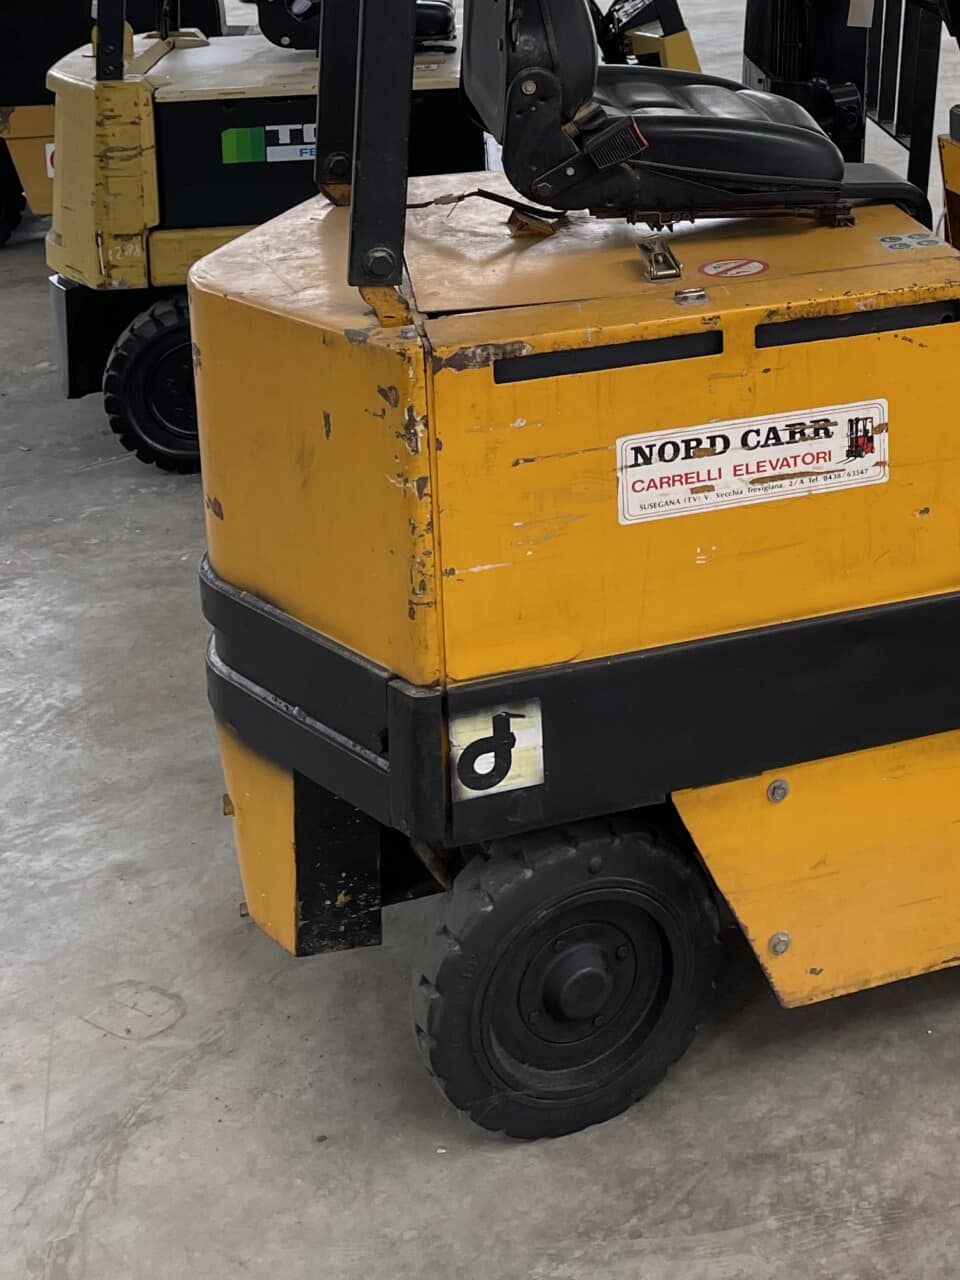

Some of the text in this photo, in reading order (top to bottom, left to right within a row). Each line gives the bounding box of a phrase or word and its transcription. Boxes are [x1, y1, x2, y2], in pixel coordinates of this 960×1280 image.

[631, 450, 832, 493] CARRELLI ELEVATORI
[639, 498, 681, 511] SUSEGANA
[716, 489, 743, 499] Vecchia
[788, 479, 805, 487] 2/A
